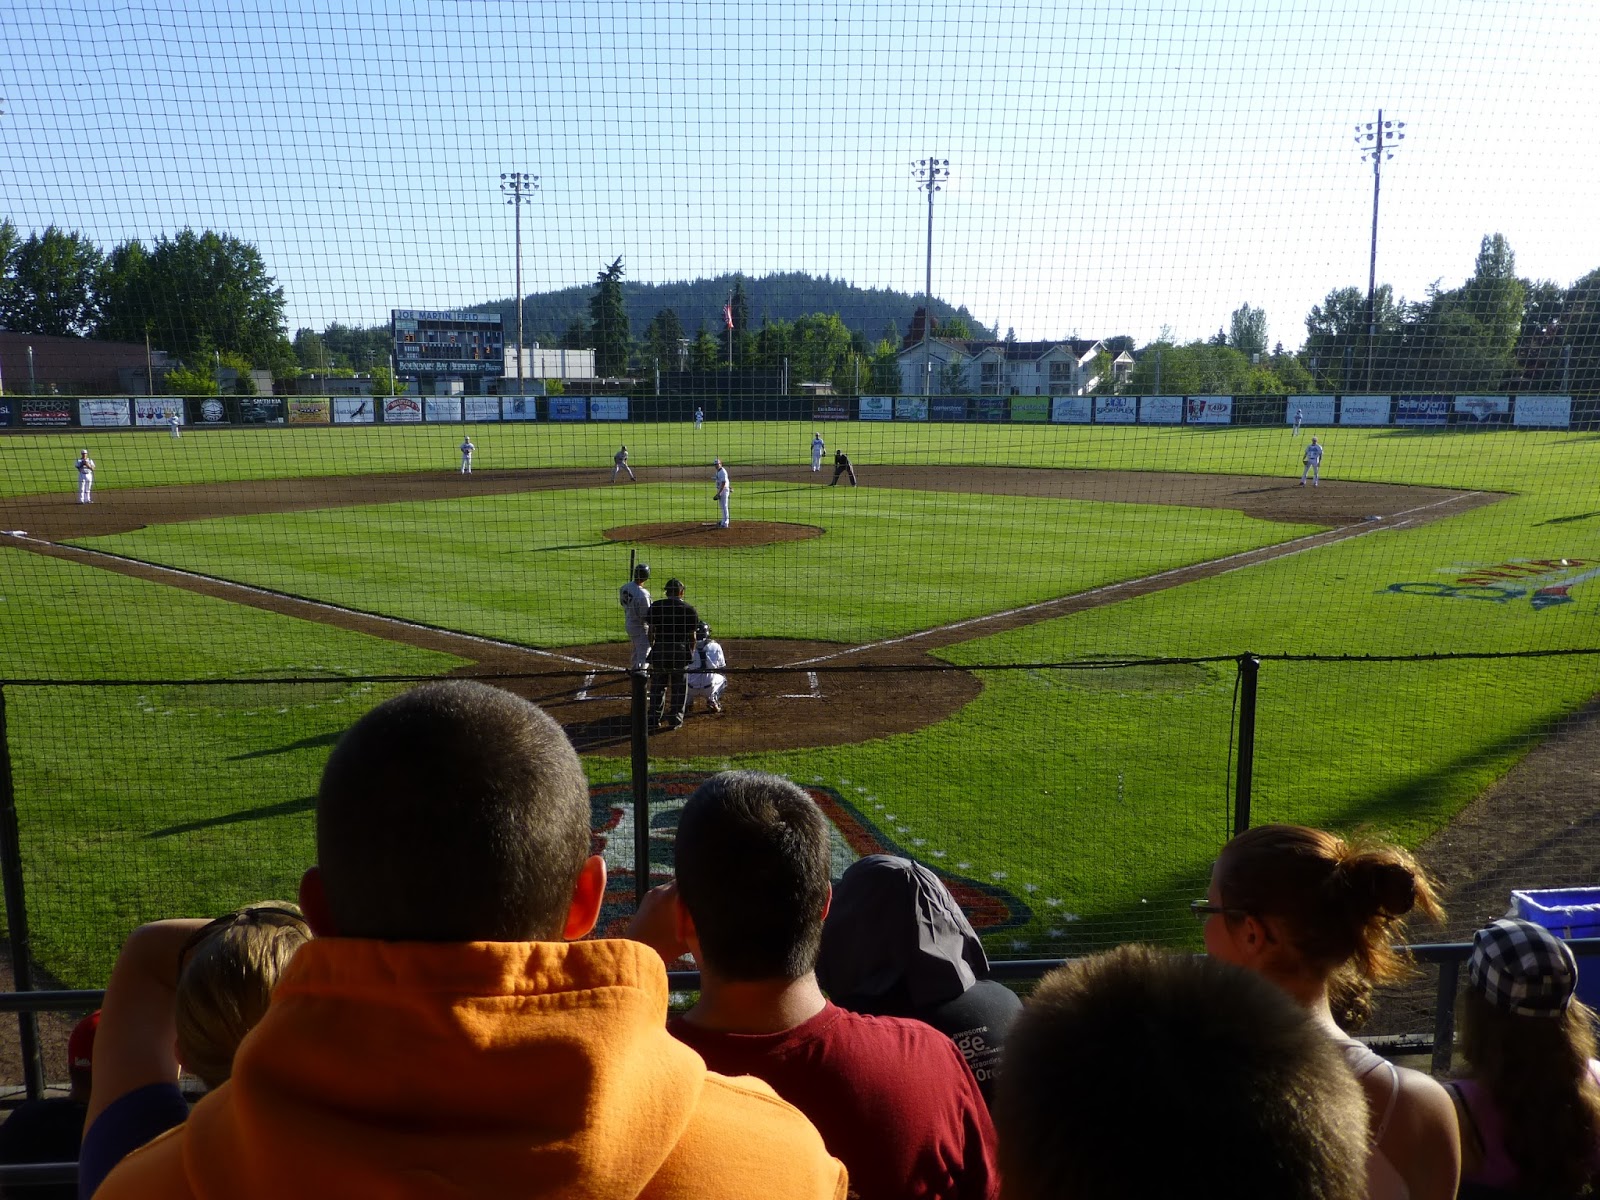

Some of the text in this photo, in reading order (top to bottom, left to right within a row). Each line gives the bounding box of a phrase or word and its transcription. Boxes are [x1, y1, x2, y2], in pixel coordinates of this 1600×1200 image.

[397, 311, 414, 320] JOE
[418, 312, 452, 320] MARTIN
[436, 362, 448, 371] BAY
[1398, 399, 1447, 411] Bellingham
[1096, 407, 1135, 415] SPORTSPLEX
[953, 1025, 988, 1040] awesome
